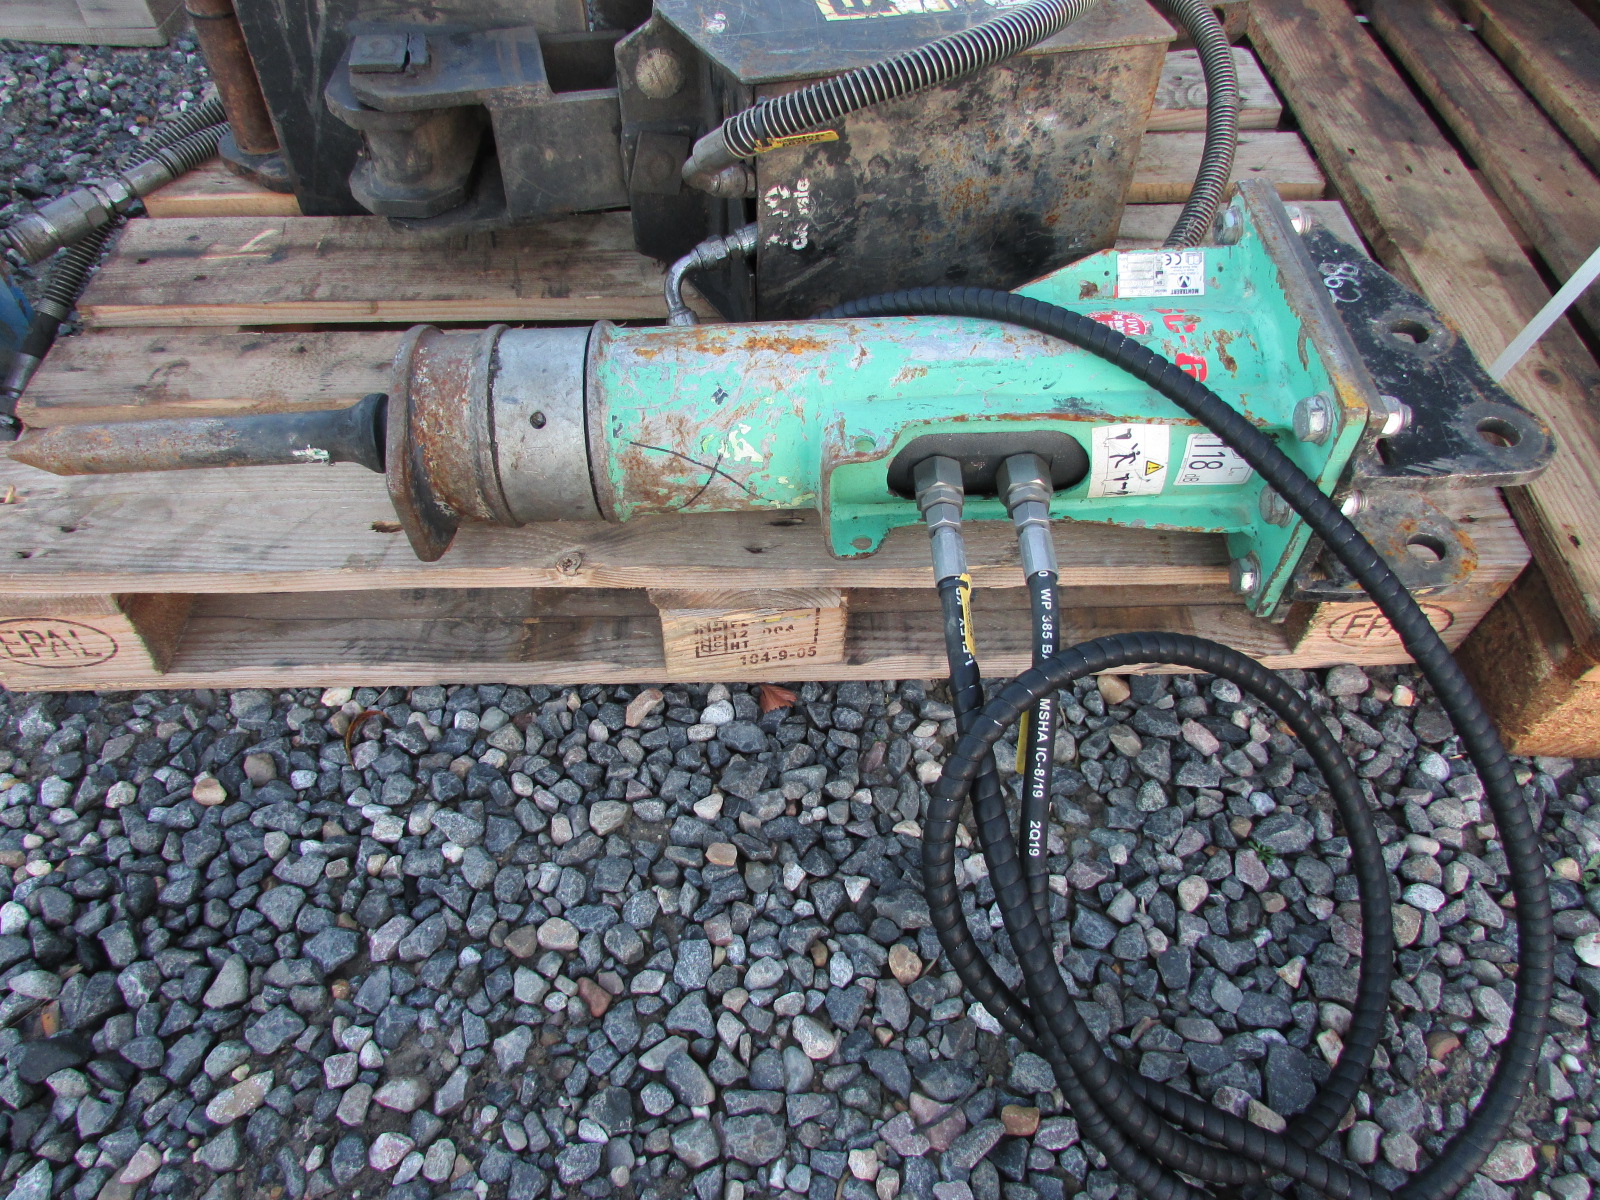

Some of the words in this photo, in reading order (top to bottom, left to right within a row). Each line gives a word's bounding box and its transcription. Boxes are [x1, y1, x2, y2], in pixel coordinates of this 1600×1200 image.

[1126, 318, 1141, 335] UVV
[1040, 588, 1052, 610] WP
[1041, 615, 1053, 639] 385
[0, 629, 103, 658] EPAL
[730, 640, 750, 651] HT
[1036, 698, 1051, 743] MSHA
[1032, 747, 1047, 798] IC-8/19
[1028, 820, 1041, 857] 2Q19
